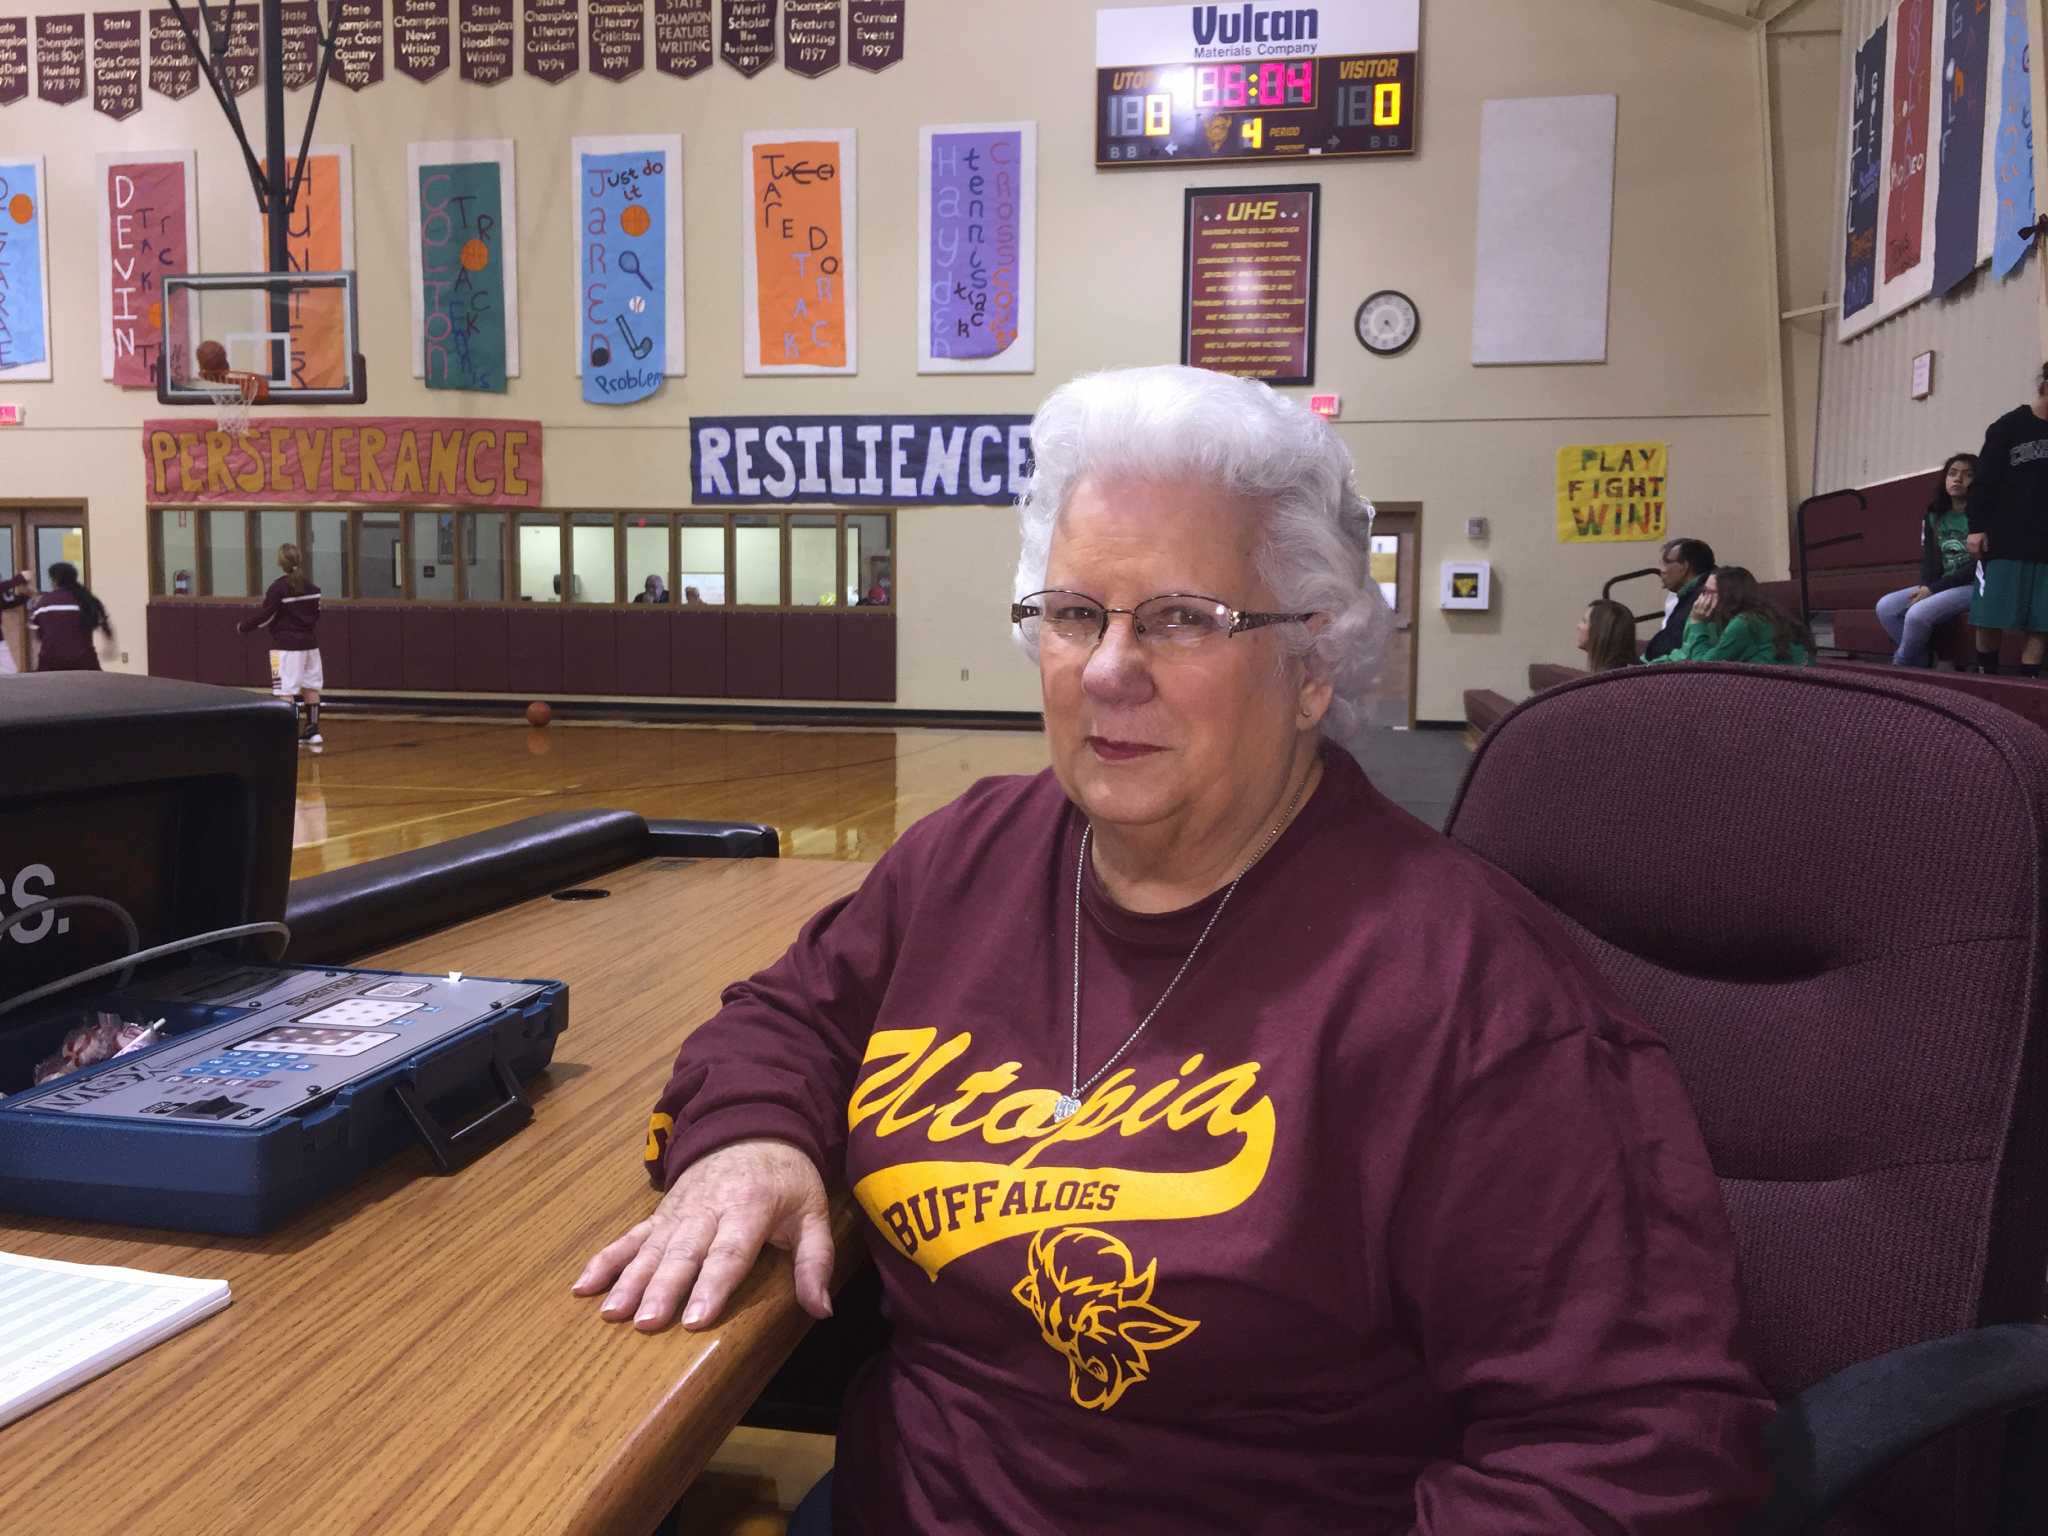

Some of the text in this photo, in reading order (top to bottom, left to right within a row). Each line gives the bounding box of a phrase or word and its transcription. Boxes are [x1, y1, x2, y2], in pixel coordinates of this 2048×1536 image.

[341, 3, 371, 17] State
[405, 0, 437, 12] State
[471, 4, 501, 17] State
[589, 1, 644, 16] Champion
[732, 3, 767, 16] Merit
[394, 16, 449, 29] Champion
[525, 9, 579, 24] Champion
[594, 17, 640, 30] Literary
[656, 11, 712, 26] CHAMPION
[728, 16, 771, 30] Scholar
[853, 12, 898, 25] Current
[46, 22, 75, 34] State
[103, 18, 132, 31] State
[460, 19, 513, 34] Champion
[791, 18, 836, 31] Feature
[1193, 3, 1319, 46] Vulcan
[405, 29, 437, 42] News
[532, 26, 576, 39] Literary
[592, 30, 641, 42] Criticism
[659, 25, 710, 39] FEATURE
[789, 31, 836, 47] Writing
[856, 27, 895, 41] Events
[401, 42, 441, 56] Writing
[462, 35, 510, 49] Headline
[527, 41, 576, 53] Criticism
[599, 42, 632, 54] Team
[660, 40, 711, 53] WRITING
[334, 48, 376, 62] Country
[466, 50, 506, 64] Writing
[800, 47, 828, 61] 1997
[862, 44, 891, 57] 1997
[1194, 43, 1319, 59] Materials Company
[408, 55, 436, 68] 1993
[1340, 58, 1399, 80] VISITOR
[1242, 117, 1263, 149] 4
[1226, 200, 1280, 222] UHS
[112, 175, 139, 358] DEVIN
[150, 425, 530, 498] PERSEVERANCE
[698, 424, 1032, 498] RESILIENCE
[1581, 447, 1658, 472] PLAY
[1568, 477, 1665, 501] FIGHT
[1571, 501, 1664, 536] WIN!
[848, 1026, 1265, 1169] Utopia
[882, 1180, 1121, 1256] BUFFALOES
